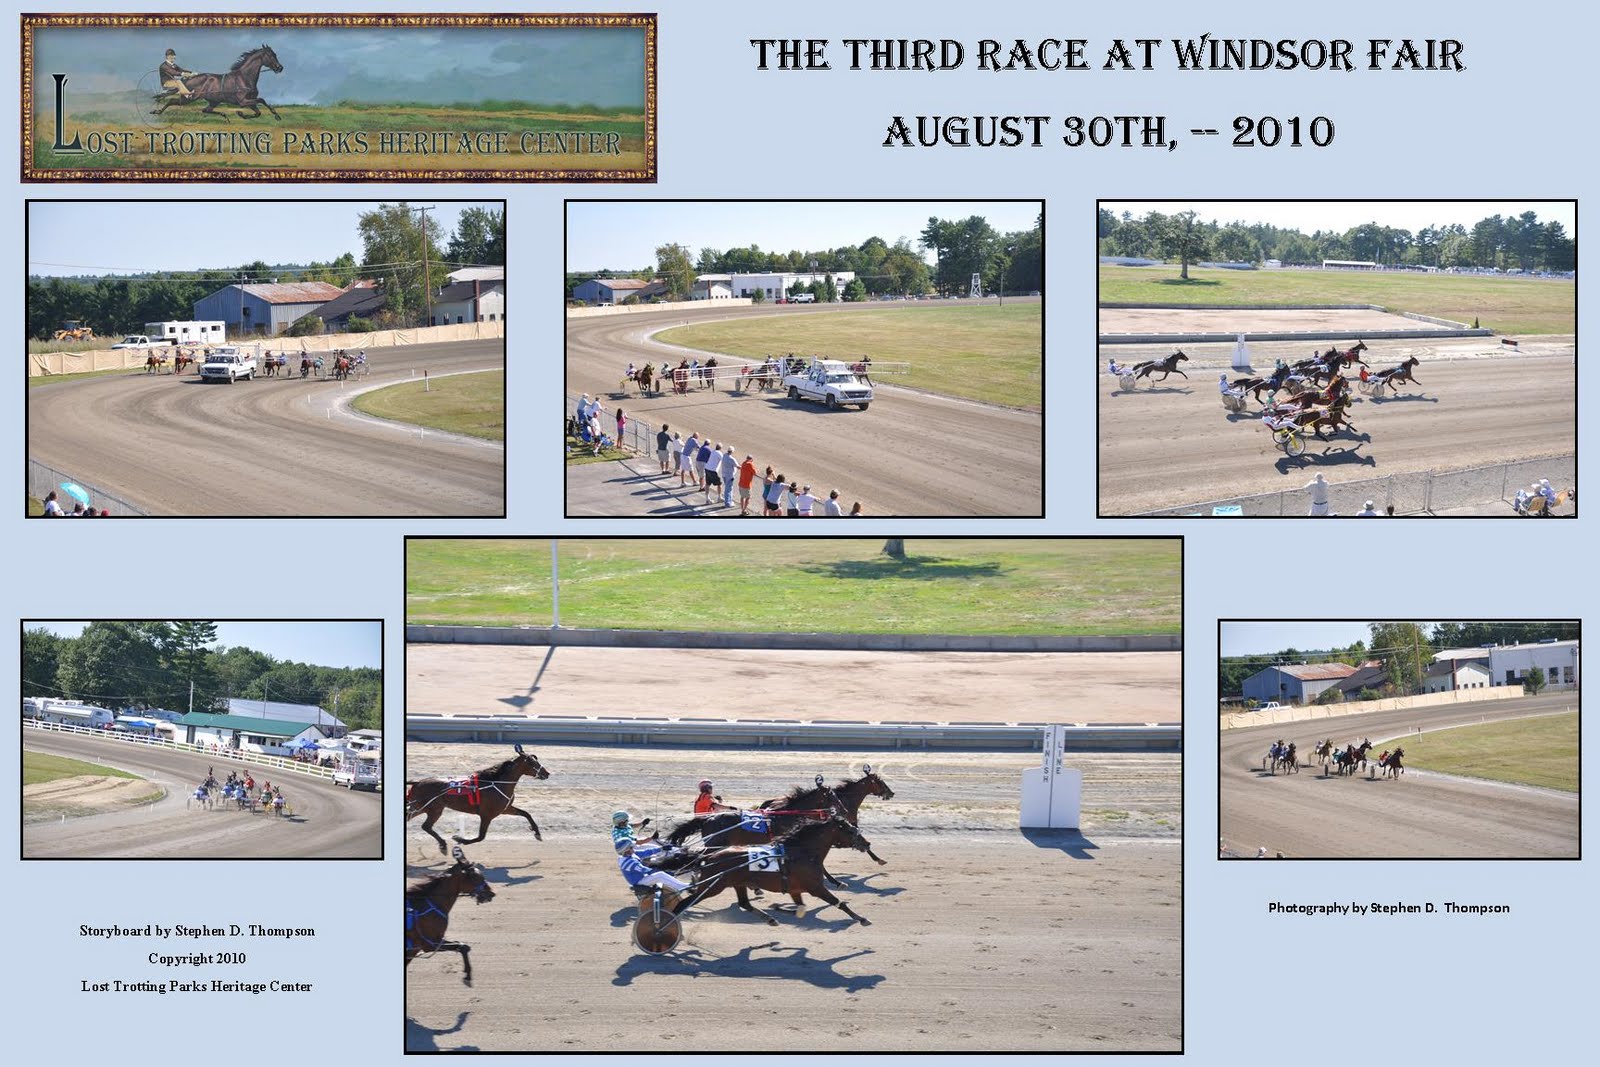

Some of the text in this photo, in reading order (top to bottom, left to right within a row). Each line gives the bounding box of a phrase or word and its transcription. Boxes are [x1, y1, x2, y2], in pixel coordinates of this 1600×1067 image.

[1043, 732, 1051, 783] FINISH
[830, 807, 837, 816] 3
[453, 847, 462, 859] 5
